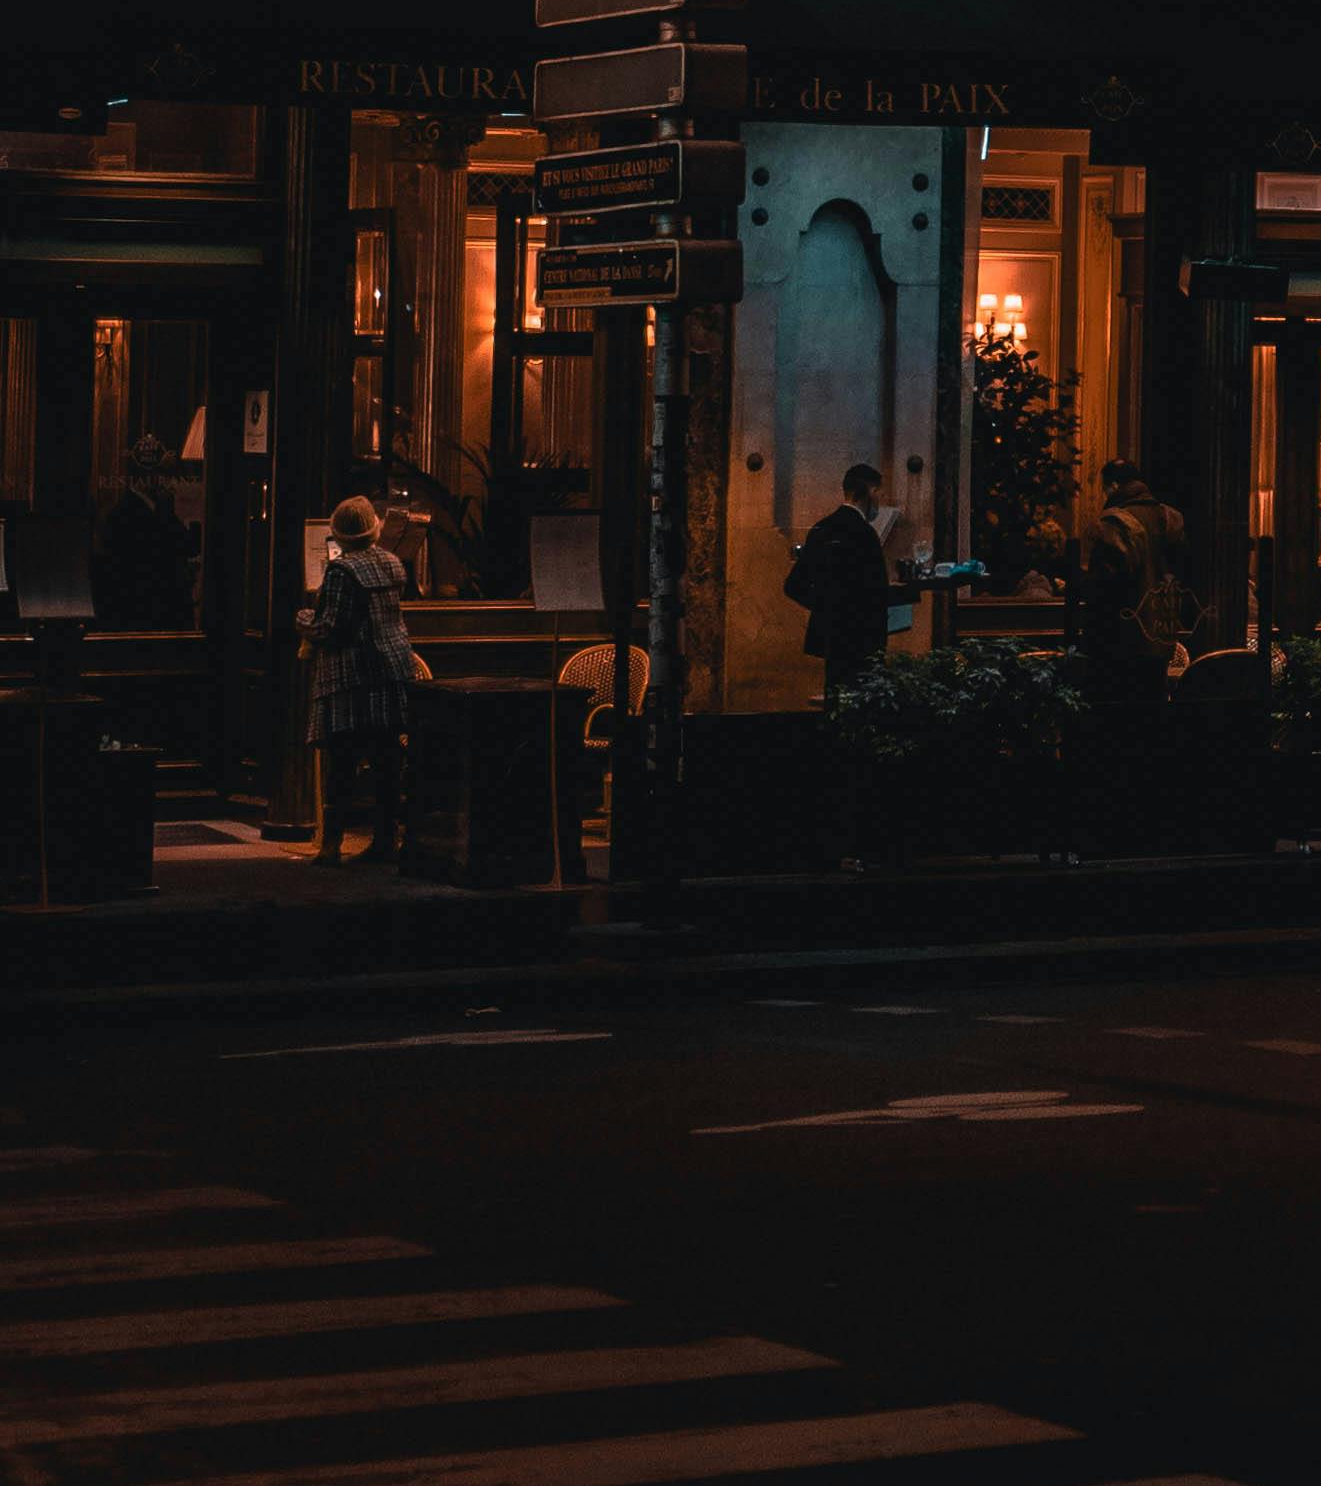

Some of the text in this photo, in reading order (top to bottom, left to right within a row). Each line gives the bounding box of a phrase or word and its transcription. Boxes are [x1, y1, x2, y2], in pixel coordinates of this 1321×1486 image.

[297, 60, 529, 100] RESTAURA
[800, 76, 844, 112] de
[864, 79, 896, 113] la
[920, 83, 1010, 115] PAIX
